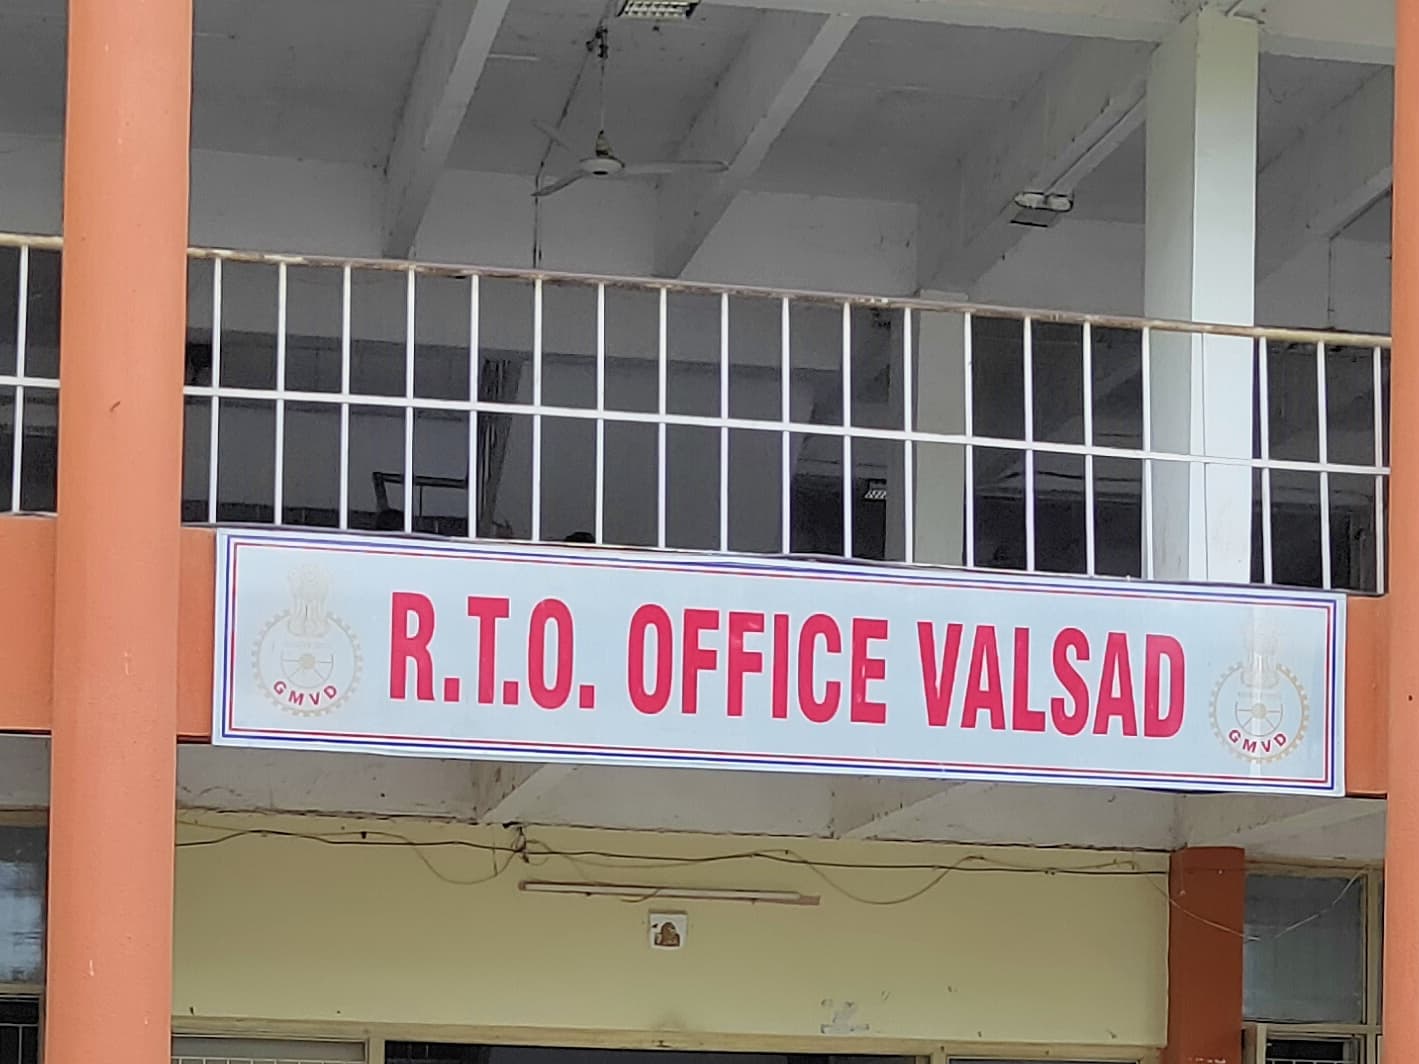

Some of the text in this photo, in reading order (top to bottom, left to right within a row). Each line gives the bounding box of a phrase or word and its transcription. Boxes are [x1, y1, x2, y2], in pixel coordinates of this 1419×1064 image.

[390, 591, 1185, 738] R.T.O. OFFICE VALSAD
[273, 681, 338, 705] GMVD
[1228, 729, 1287, 753] GMVD
